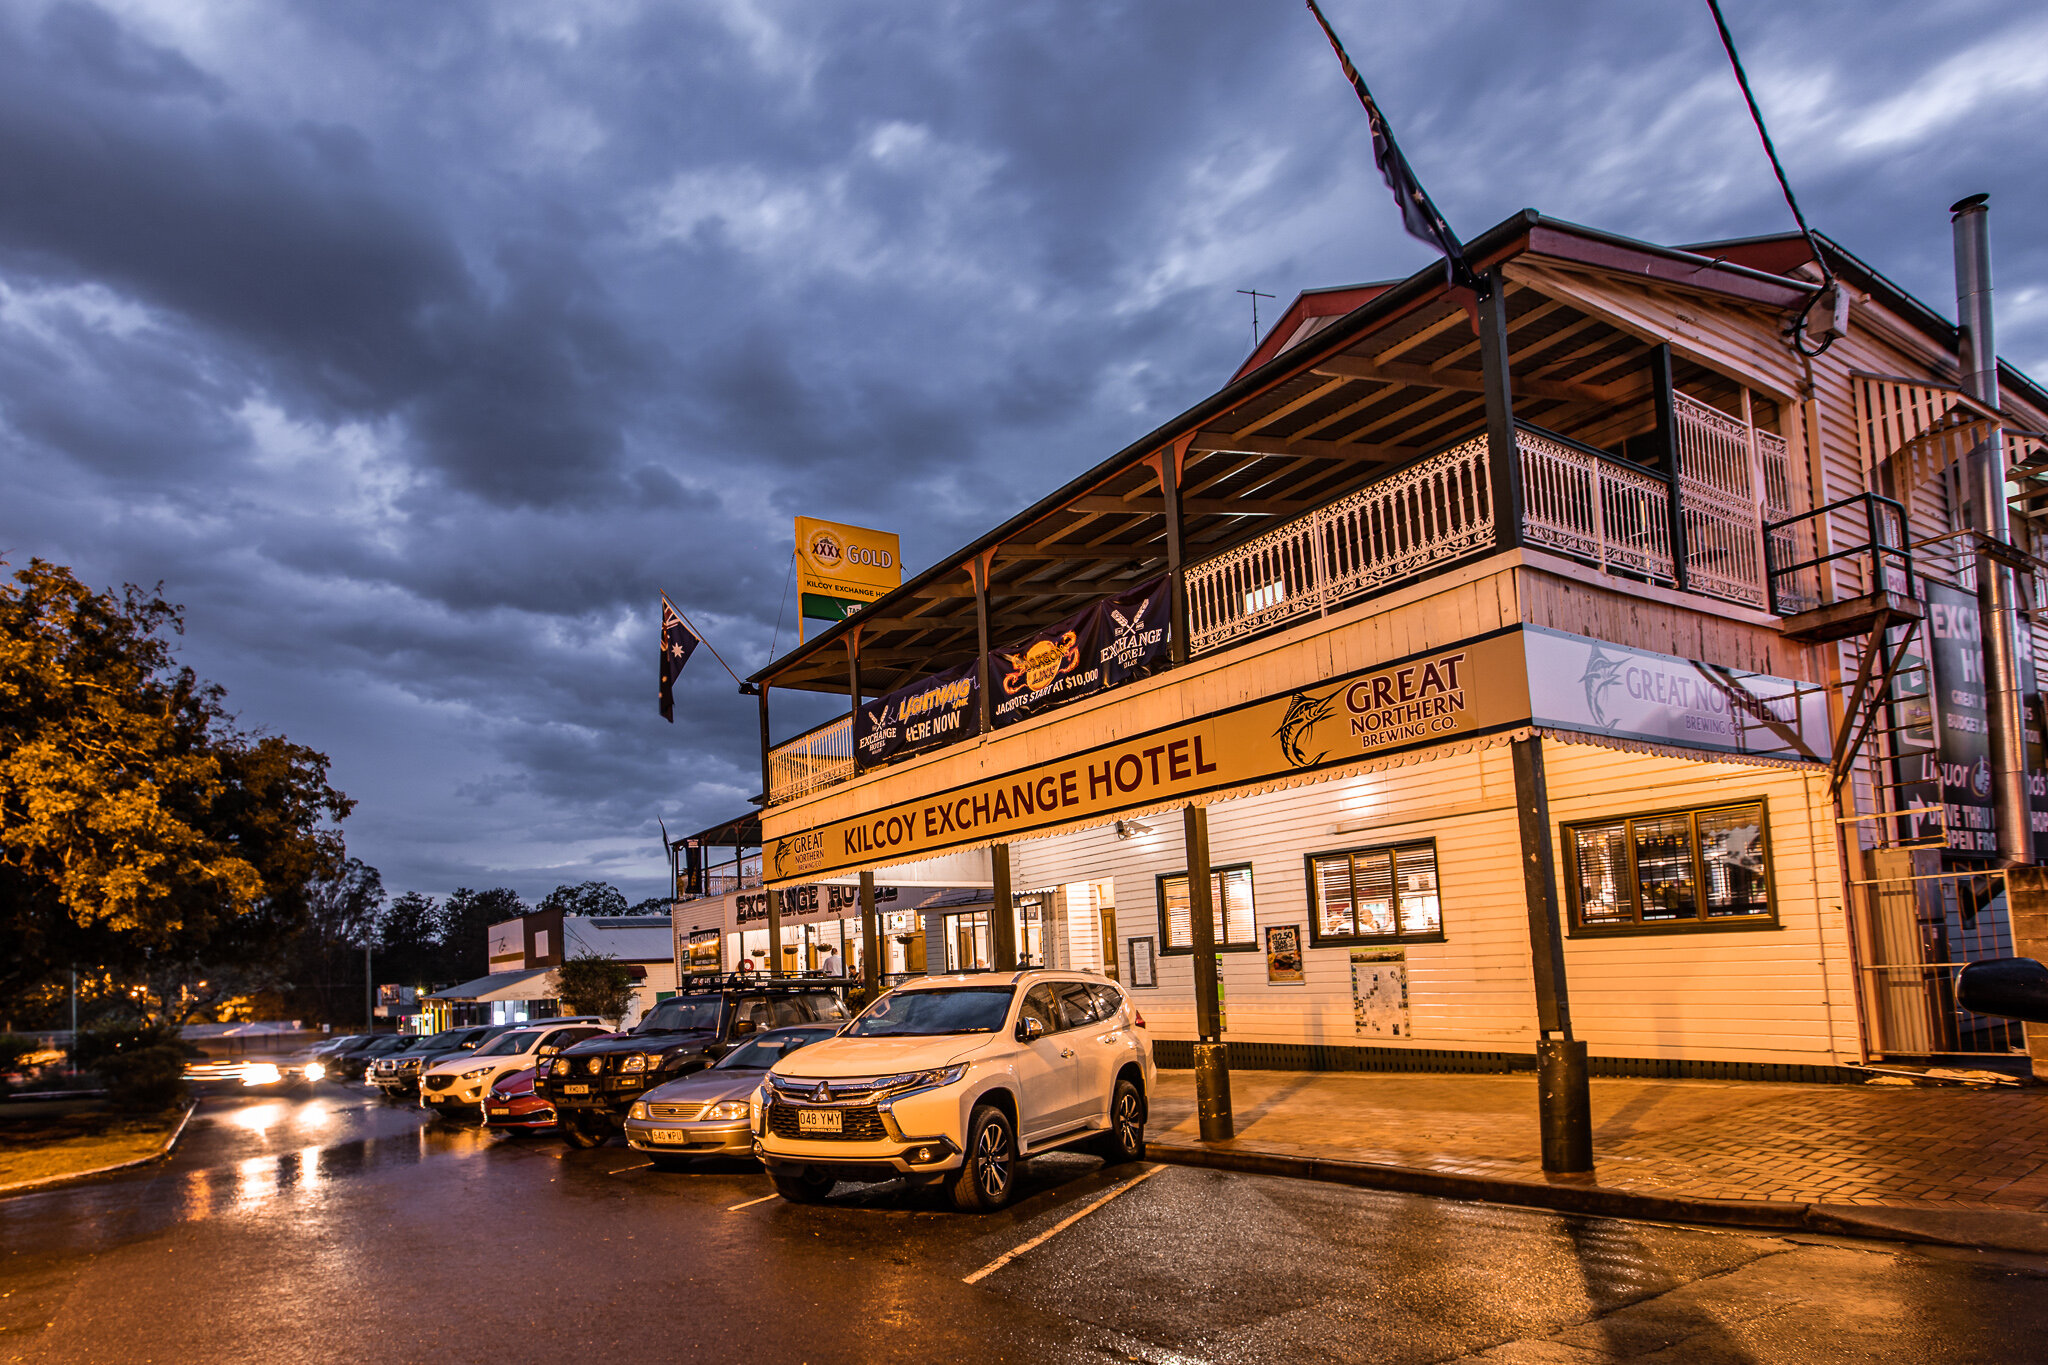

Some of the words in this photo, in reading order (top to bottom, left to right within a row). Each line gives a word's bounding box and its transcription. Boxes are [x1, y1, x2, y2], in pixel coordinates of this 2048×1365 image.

[812, 543, 842, 560] XXXX
[846, 544, 893, 569] GOLD
[806, 579, 833, 591] KILCOY
[835, 584, 874, 597] EXCHANGE
[1100, 628, 1162, 664] EXCHANGE
[995, 693, 1029, 716] JACKPOTS
[1029, 683, 1054, 702] START
[1052, 678, 1064, 693] AT
[1065, 668, 1099, 690] $10,000
[1345, 651, 1467, 714] GREAT
[1625, 666, 1692, 709] GREAT
[1694, 681, 1798, 722] NORTHERN
[952, 696, 969, 711] LINK
[1350, 690, 1466, 737] NORTHERN
[905, 720, 931, 743] HERE
[932, 709, 961, 735] NOW
[1362, 722, 1426, 749] BREWING
[1431, 716, 1458, 732] CO.
[1685, 714, 1726, 737] BREWING
[859, 727, 897, 750] EXCHANGE
[869, 739, 886, 752] HOTEL
[844, 811, 917, 856] KILCOY
[923, 769, 1080, 838] EXCHANGE
[1088, 734, 1218, 801] HOTEL
[793, 831, 824, 854] GREAT
[1976, 831, 1997, 851] FRO
[794, 848, 824, 865] NORTHERN
[737, 884, 819, 925] EXCANGE
[827, 884, 898, 914] HOEL
[800, 1112, 816, 1125] 048
[820, 1113, 841, 1126] YMY
